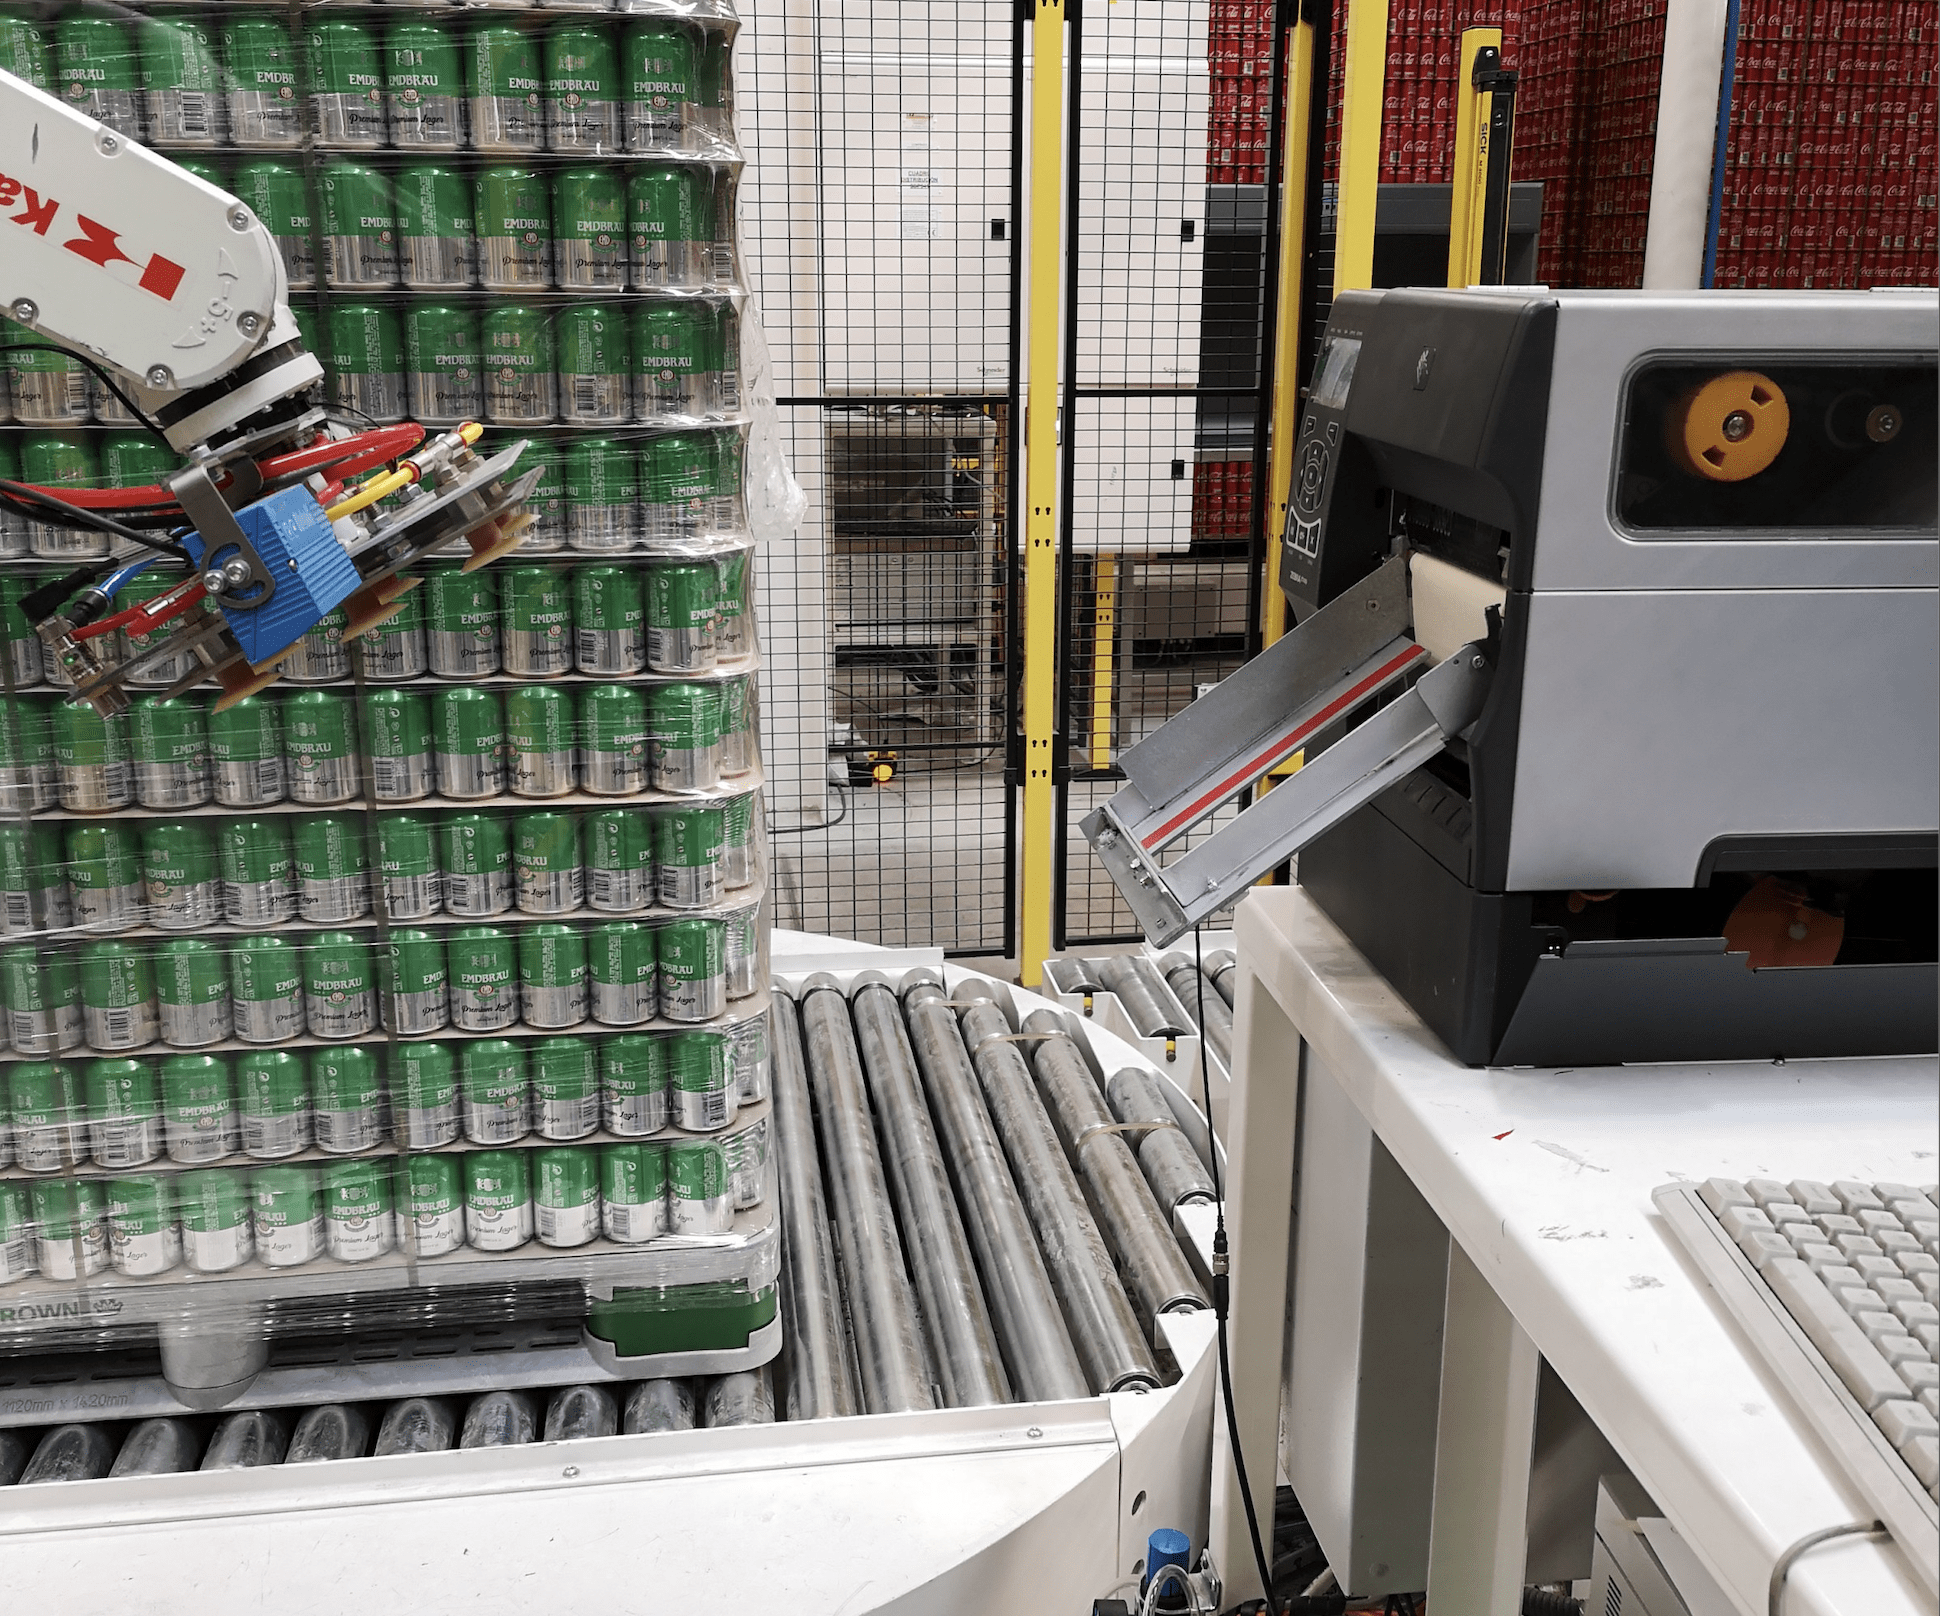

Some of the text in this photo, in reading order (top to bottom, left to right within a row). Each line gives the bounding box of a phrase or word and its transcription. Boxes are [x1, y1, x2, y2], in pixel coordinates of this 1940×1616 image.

[633, 81, 686, 94] EMDBRÄU
[1480, 122, 1488, 155] SICK
[642, 355, 692, 367] EMDBRÄU
[313, 976, 363, 991] EMDBRÄU
[461, 969, 509, 983] EMDBRÄU
[178, 1099, 230, 1117] EMDBRÄU
[332, 1201, 381, 1216] EMDBRÄU
